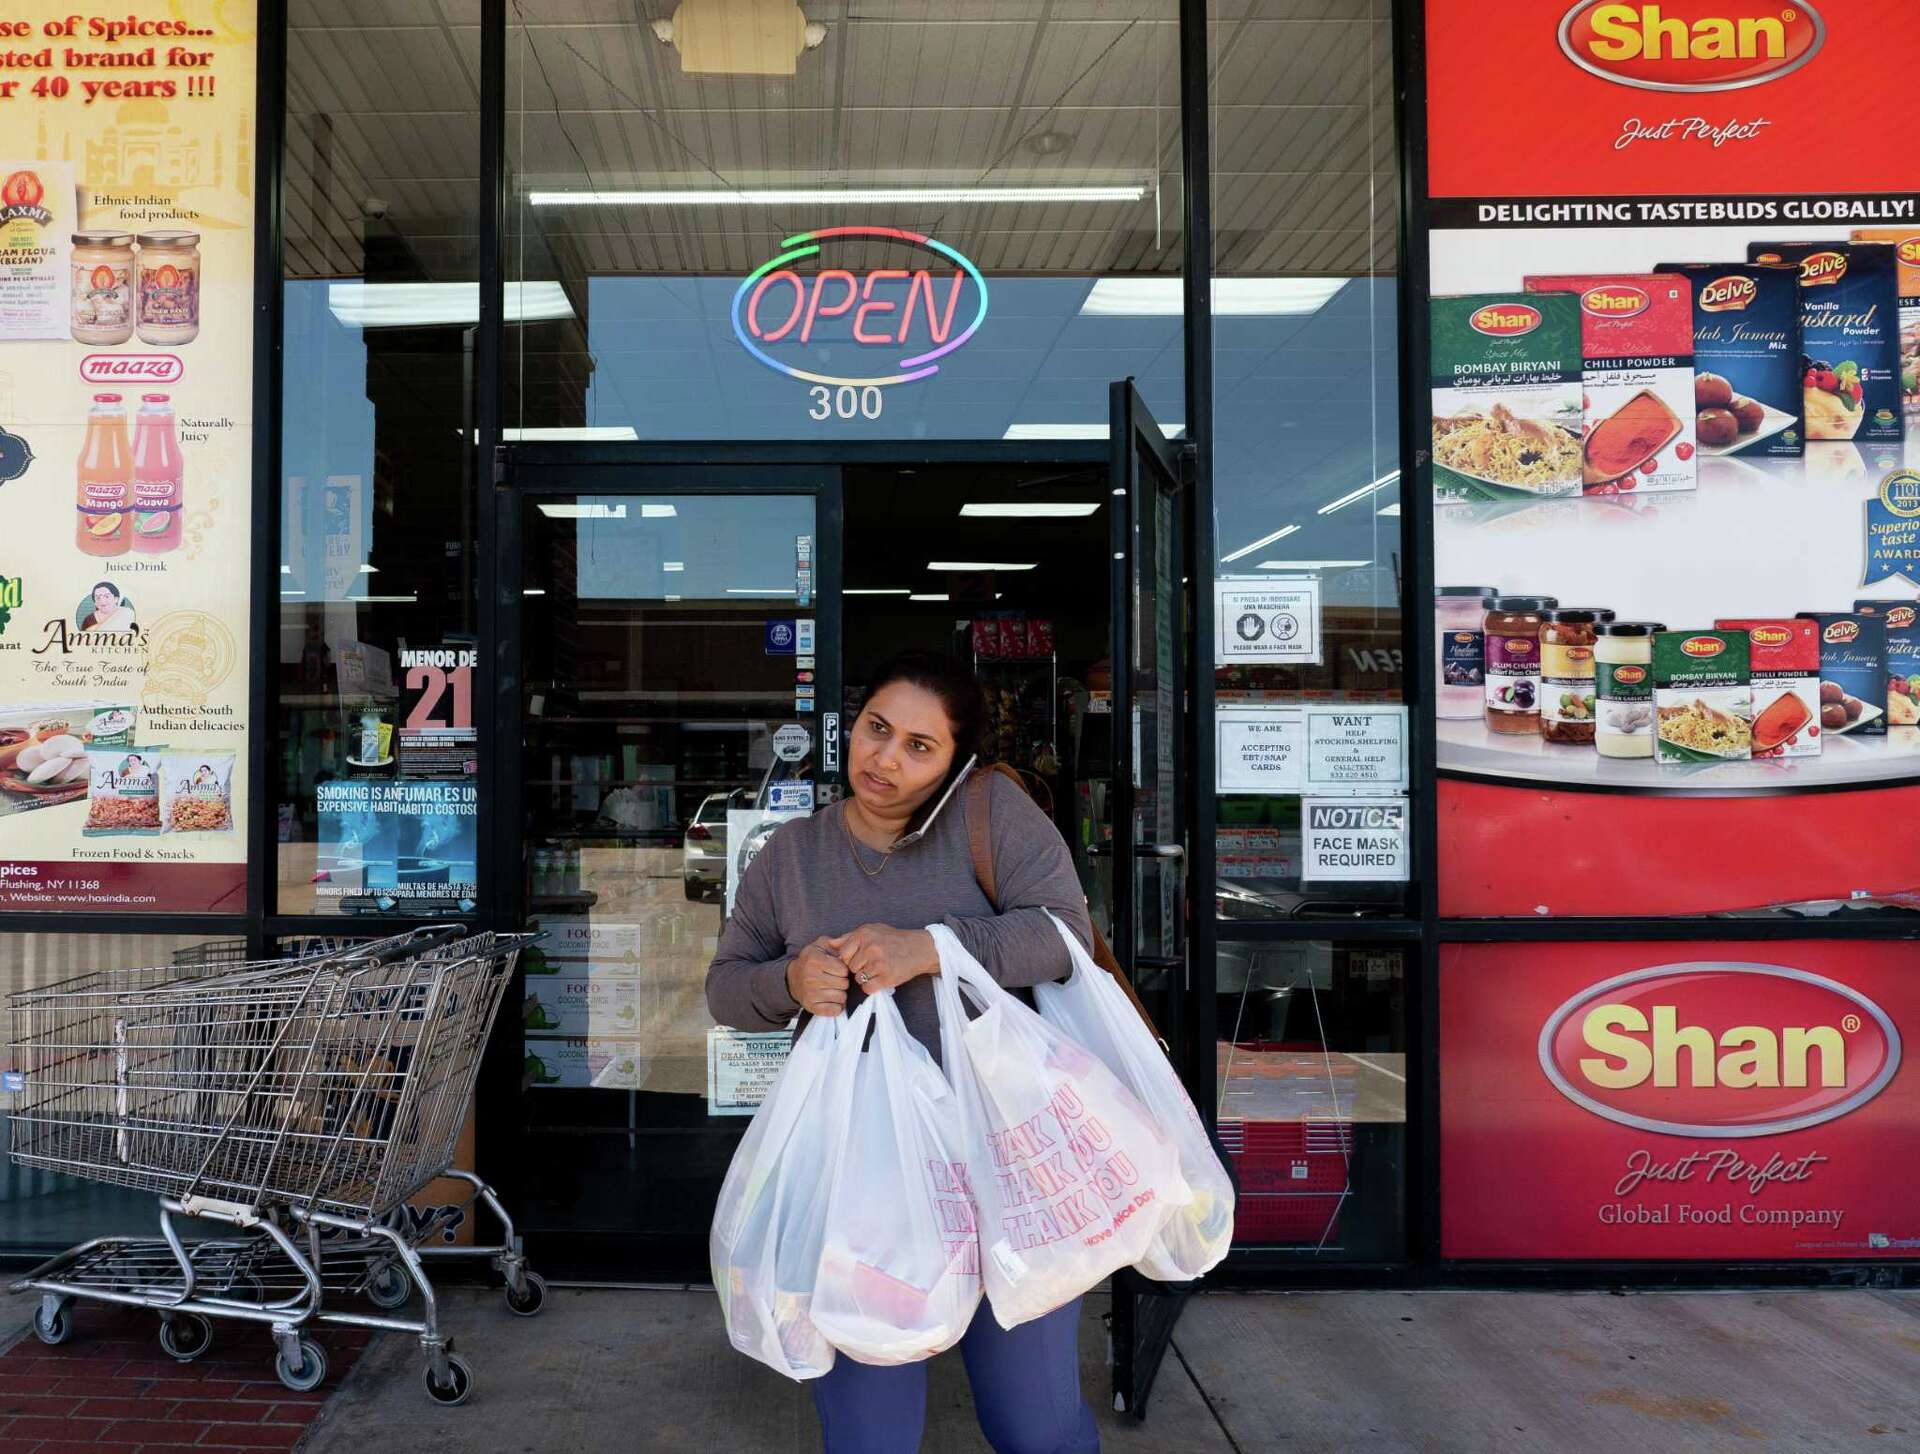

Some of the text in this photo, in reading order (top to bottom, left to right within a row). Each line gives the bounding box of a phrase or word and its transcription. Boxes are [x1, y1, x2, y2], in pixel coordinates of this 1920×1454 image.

[43, 15, 83, 36] of
[88, 16, 213, 41] Spices...
[1589, 5, 1786, 61] Shan
[65, 48, 155, 67] brand
[167, 47, 214, 67] for
[31, 76, 69, 97] 40
[81, 78, 176, 104] years
[1615, 117, 1771, 150] Just Perfect
[94, 195, 171, 206] Ethnic Indian
[120, 209, 199, 222] food products
[1478, 200, 1915, 222] DELIGHTING TASTEBUDS GLOBALLY!
[1702, 281, 1754, 303] Delve
[748, 270, 964, 343] OPEN
[1586, 291, 1641, 310] Shan
[1804, 302, 1839, 311] Vanilla
[1475, 311, 1533, 329] Shan
[1842, 327, 1880, 336] Powder
[1768, 342, 1787, 350] Mix
[88, 361, 174, 377] maaza
[1454, 360, 1561, 375] BOMBAY BIRYANI
[1584, 357, 1676, 369] CHILLI POWDER
[810, 386, 882, 420] 300
[181, 418, 235, 428] Naturally
[180, 432, 209, 442] Juicy
[87, 498, 124, 509] Mango
[136, 496, 169, 506] Guava
[1881, 533, 1916, 545] taste
[1873, 549, 1920, 559] AWARD
[104, 561, 167, 573] Juice Drink
[32, 618, 150, 655] Amma's
[1752, 631, 1788, 641] Shan
[91, 646, 150, 654] KITCHEN
[1684, 643, 1720, 653] Shan
[401, 650, 477, 667] MENOR DE
[32, 660, 151, 678] The True Taste of
[50, 674, 128, 687] South India
[1670, 673, 1703, 681] BOMBAY
[406, 667, 472, 729] 21
[140, 704, 233, 716] Authentic South
[149, 719, 245, 731] Indian delicacies
[1331, 716, 1372, 727] WANT
[1248, 725, 1282, 733] WE ARE
[826, 719, 837, 765] PULL
[1241, 744, 1291, 752] ACCEPTING
[1251, 763, 1281, 771] CARDS
[316, 786, 368, 800] SMOKING
[371, 787, 382, 800] IS
[399, 788, 441, 801] FUMAR
[444, 788, 460, 801] ES
[317, 801, 398, 812] EXPENSIVE HABIT
[1314, 807, 1398, 828] NOTICE
[1314, 837, 1400, 850] FACE MASK
[72, 848, 195, 859] Frozen Food & Snacks
[1319, 854, 1396, 868] REQUIRED
[0, 864, 38, 877] pices
[47, 880, 65, 889] NY
[69, 880, 100, 889] 11368
[10, 893, 156, 903] Website: www.hosindia.com
[316, 887, 343, 896] MINORS
[567, 928, 601, 939] FOCO
[567, 984, 601, 994] FOCO
[1580, 1004, 1846, 1089] Shan
[1615, 1149, 1827, 1196] Just Perfect
[1002, 1189, 1101, 1250] THANK
[1599, 1204, 1845, 1230] Global Food Company
